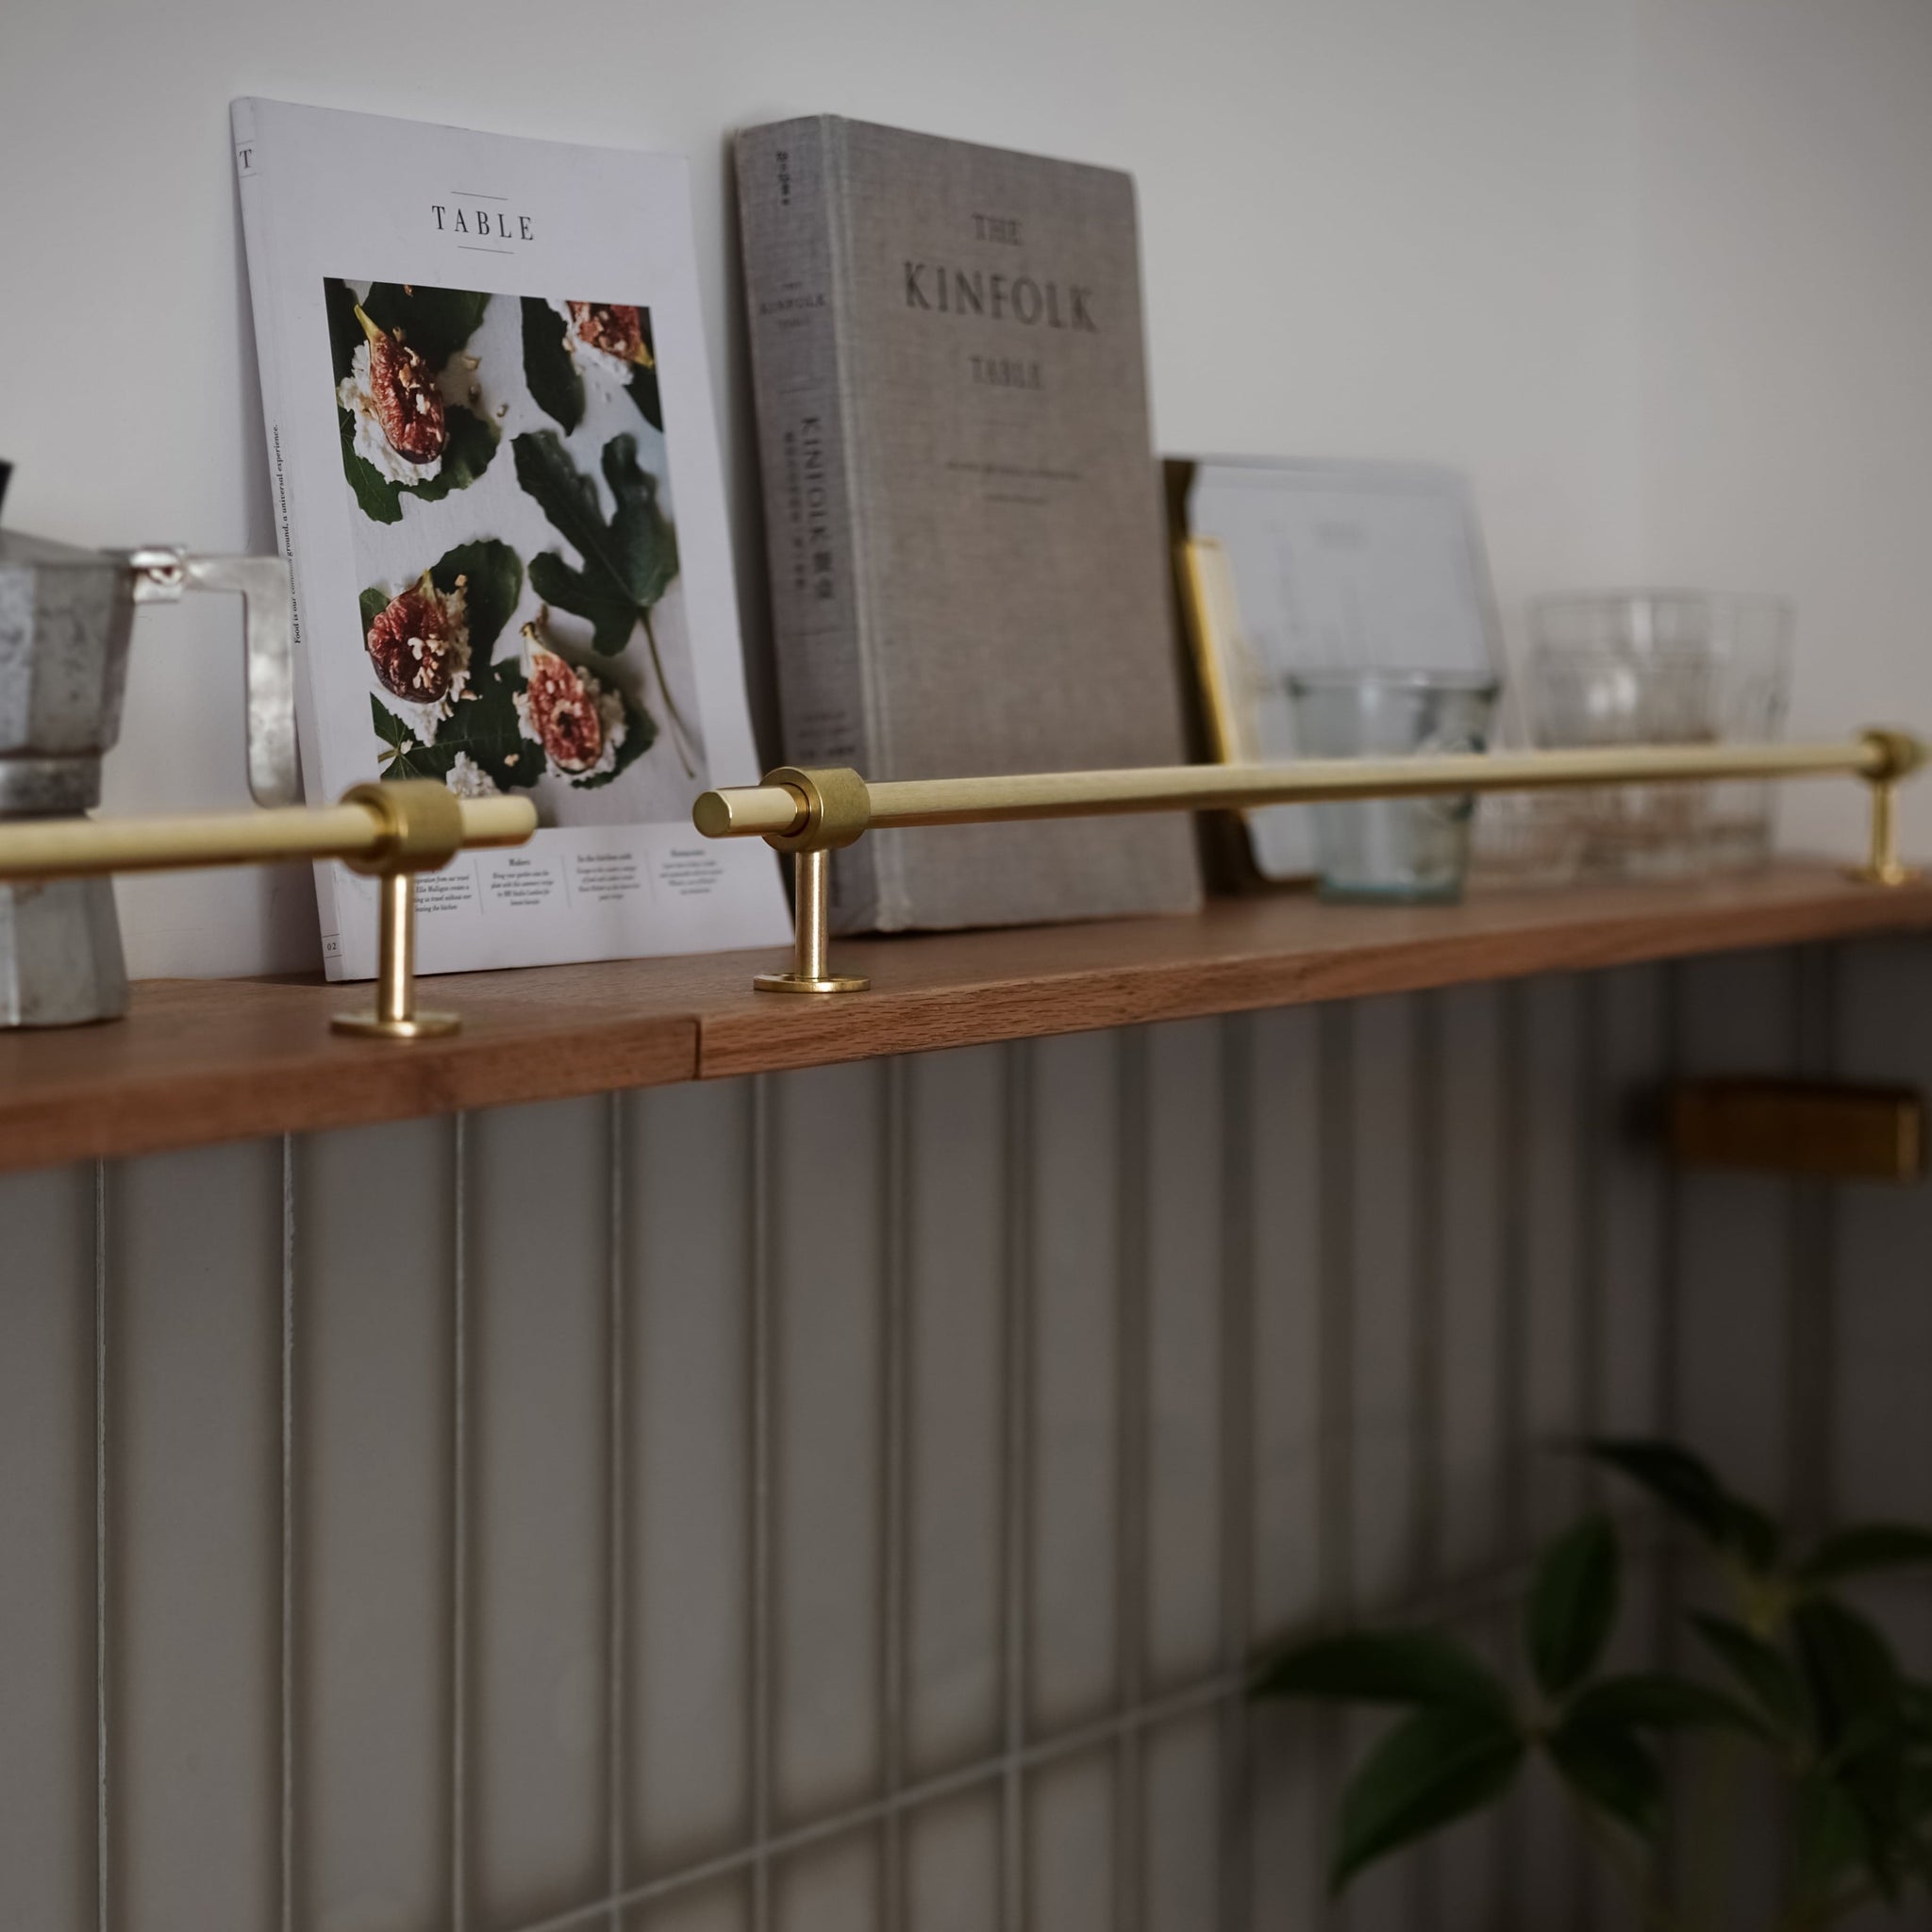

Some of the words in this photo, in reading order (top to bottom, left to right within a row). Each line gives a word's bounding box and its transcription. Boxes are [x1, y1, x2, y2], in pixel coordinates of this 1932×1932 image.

[239, 148, 252, 169] T
[431, 205, 534, 241] TABLE
[972, 212, 1023, 246] THE
[904, 260, 1098, 333] KINFOLK
[273, 424, 283, 472] experience.
[276, 474, 287, 513] universal
[282, 523, 293, 557] ground,
[292, 613, 299, 622] is
[326, 941, 337, 952] 02
